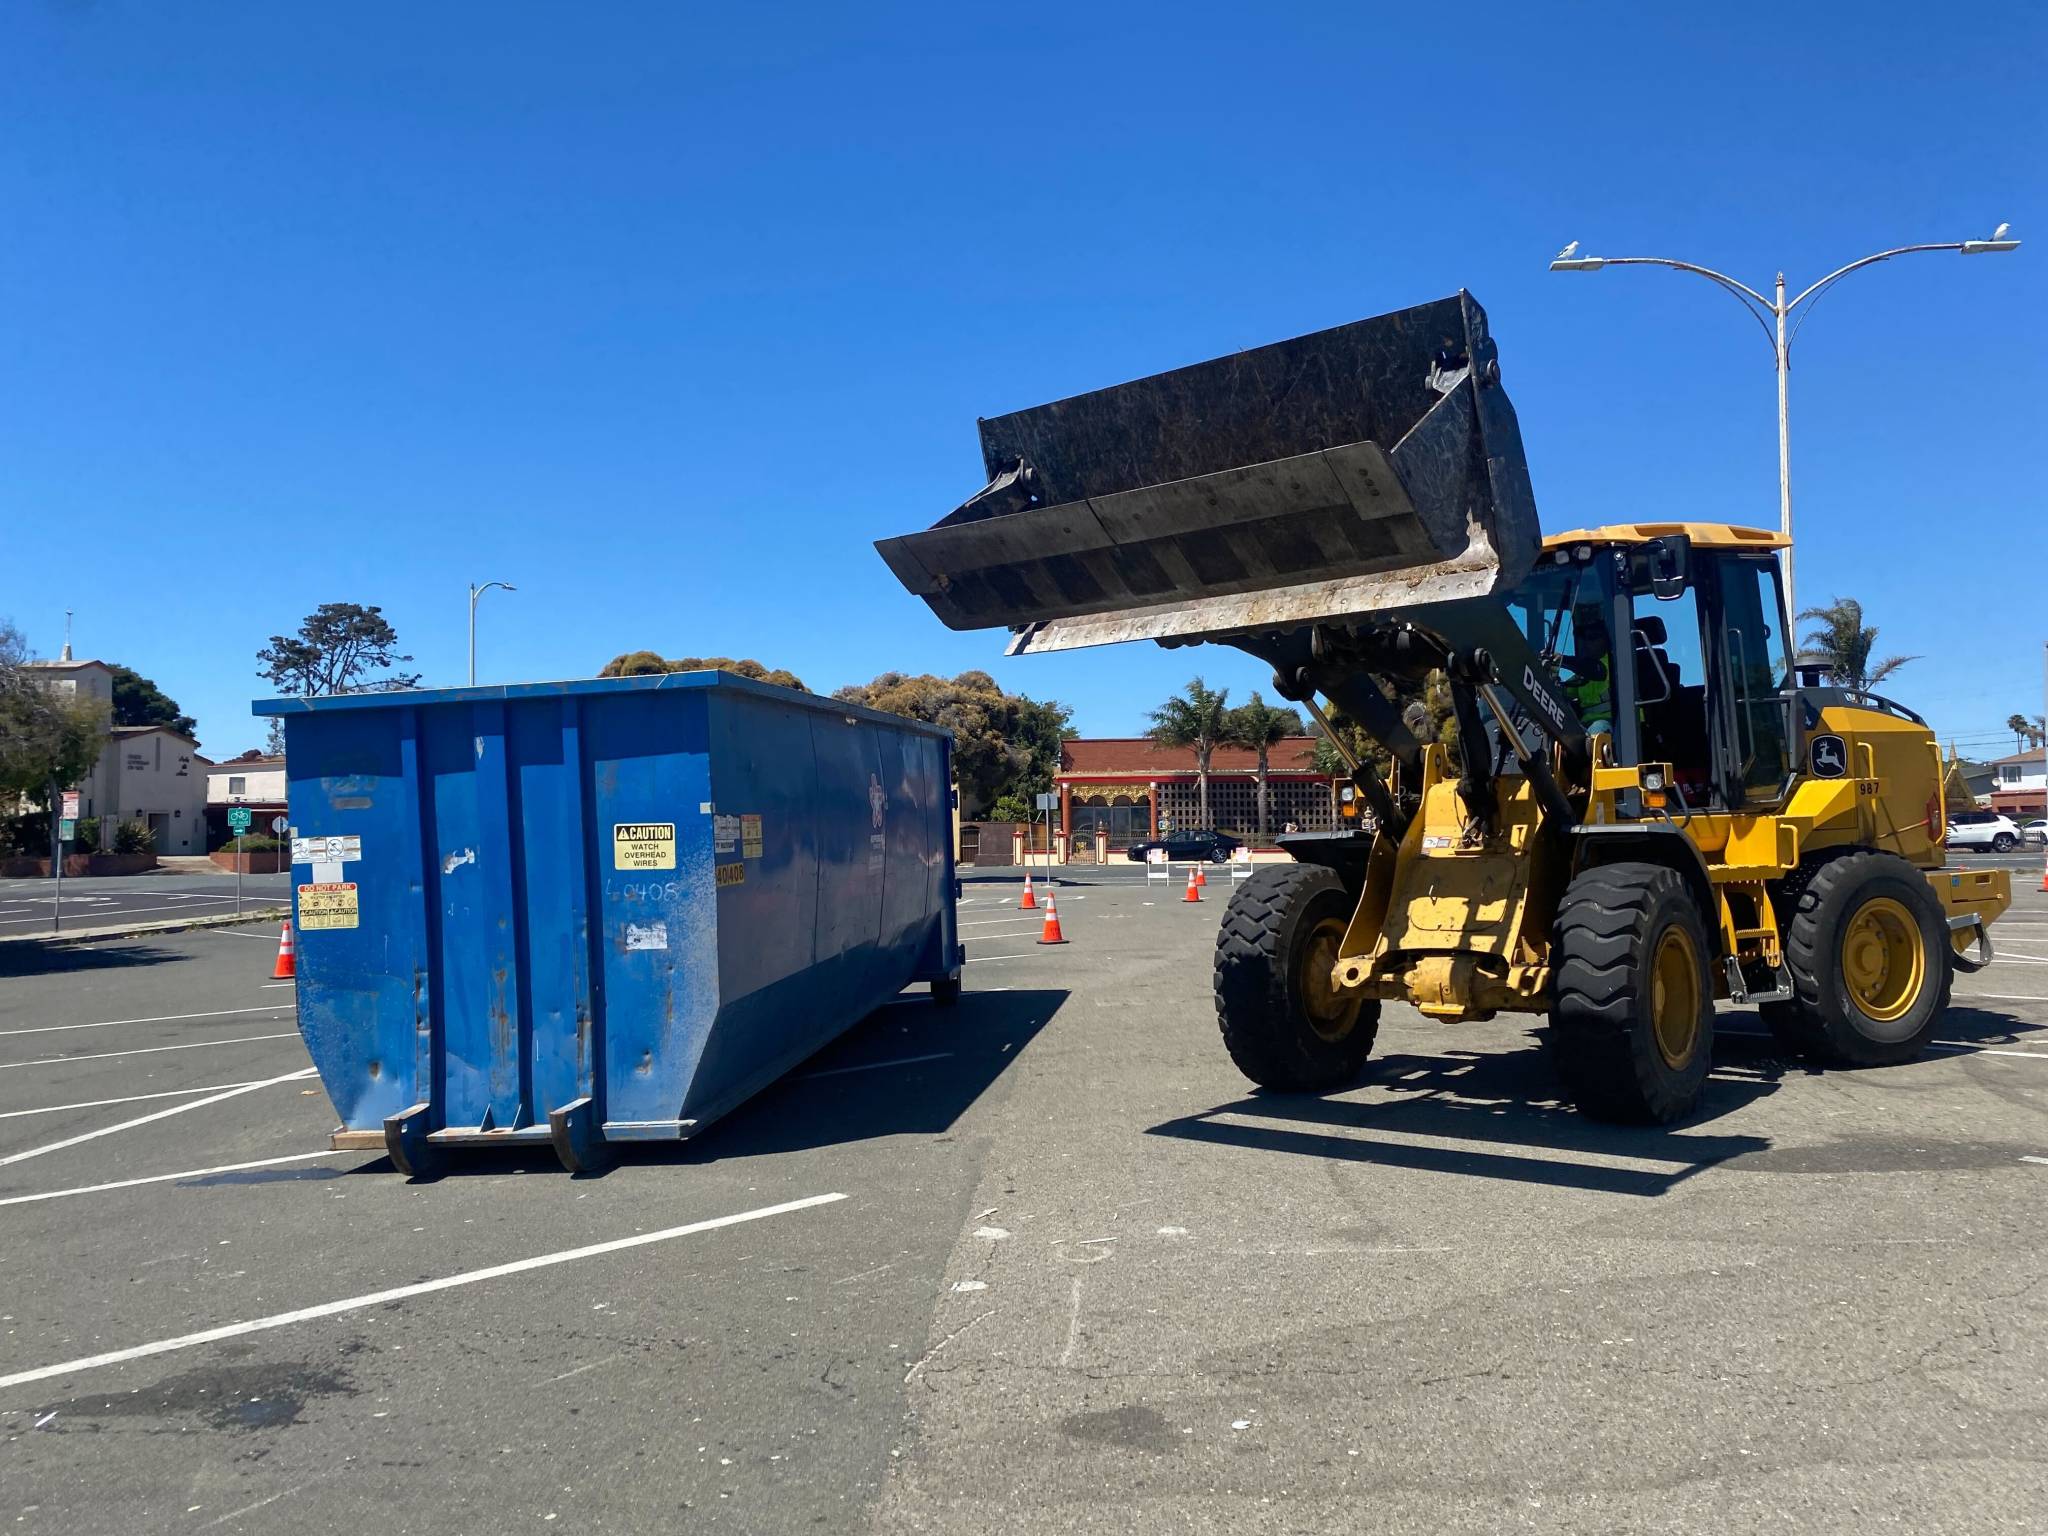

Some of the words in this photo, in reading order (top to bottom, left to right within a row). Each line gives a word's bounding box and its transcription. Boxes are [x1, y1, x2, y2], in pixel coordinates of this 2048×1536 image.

[1523, 664, 1565, 730] DEERE
[1860, 782, 1880, 796] 987
[629, 826, 671, 841] CAUTION
[631, 843, 659, 851] WATCH
[624, 851, 666, 859] OVERHEAD
[633, 859, 658, 867] WIRES
[717, 864, 744, 885] 40408
[316, 884, 330, 892] NOT
[332, 883, 352, 891] PARK
